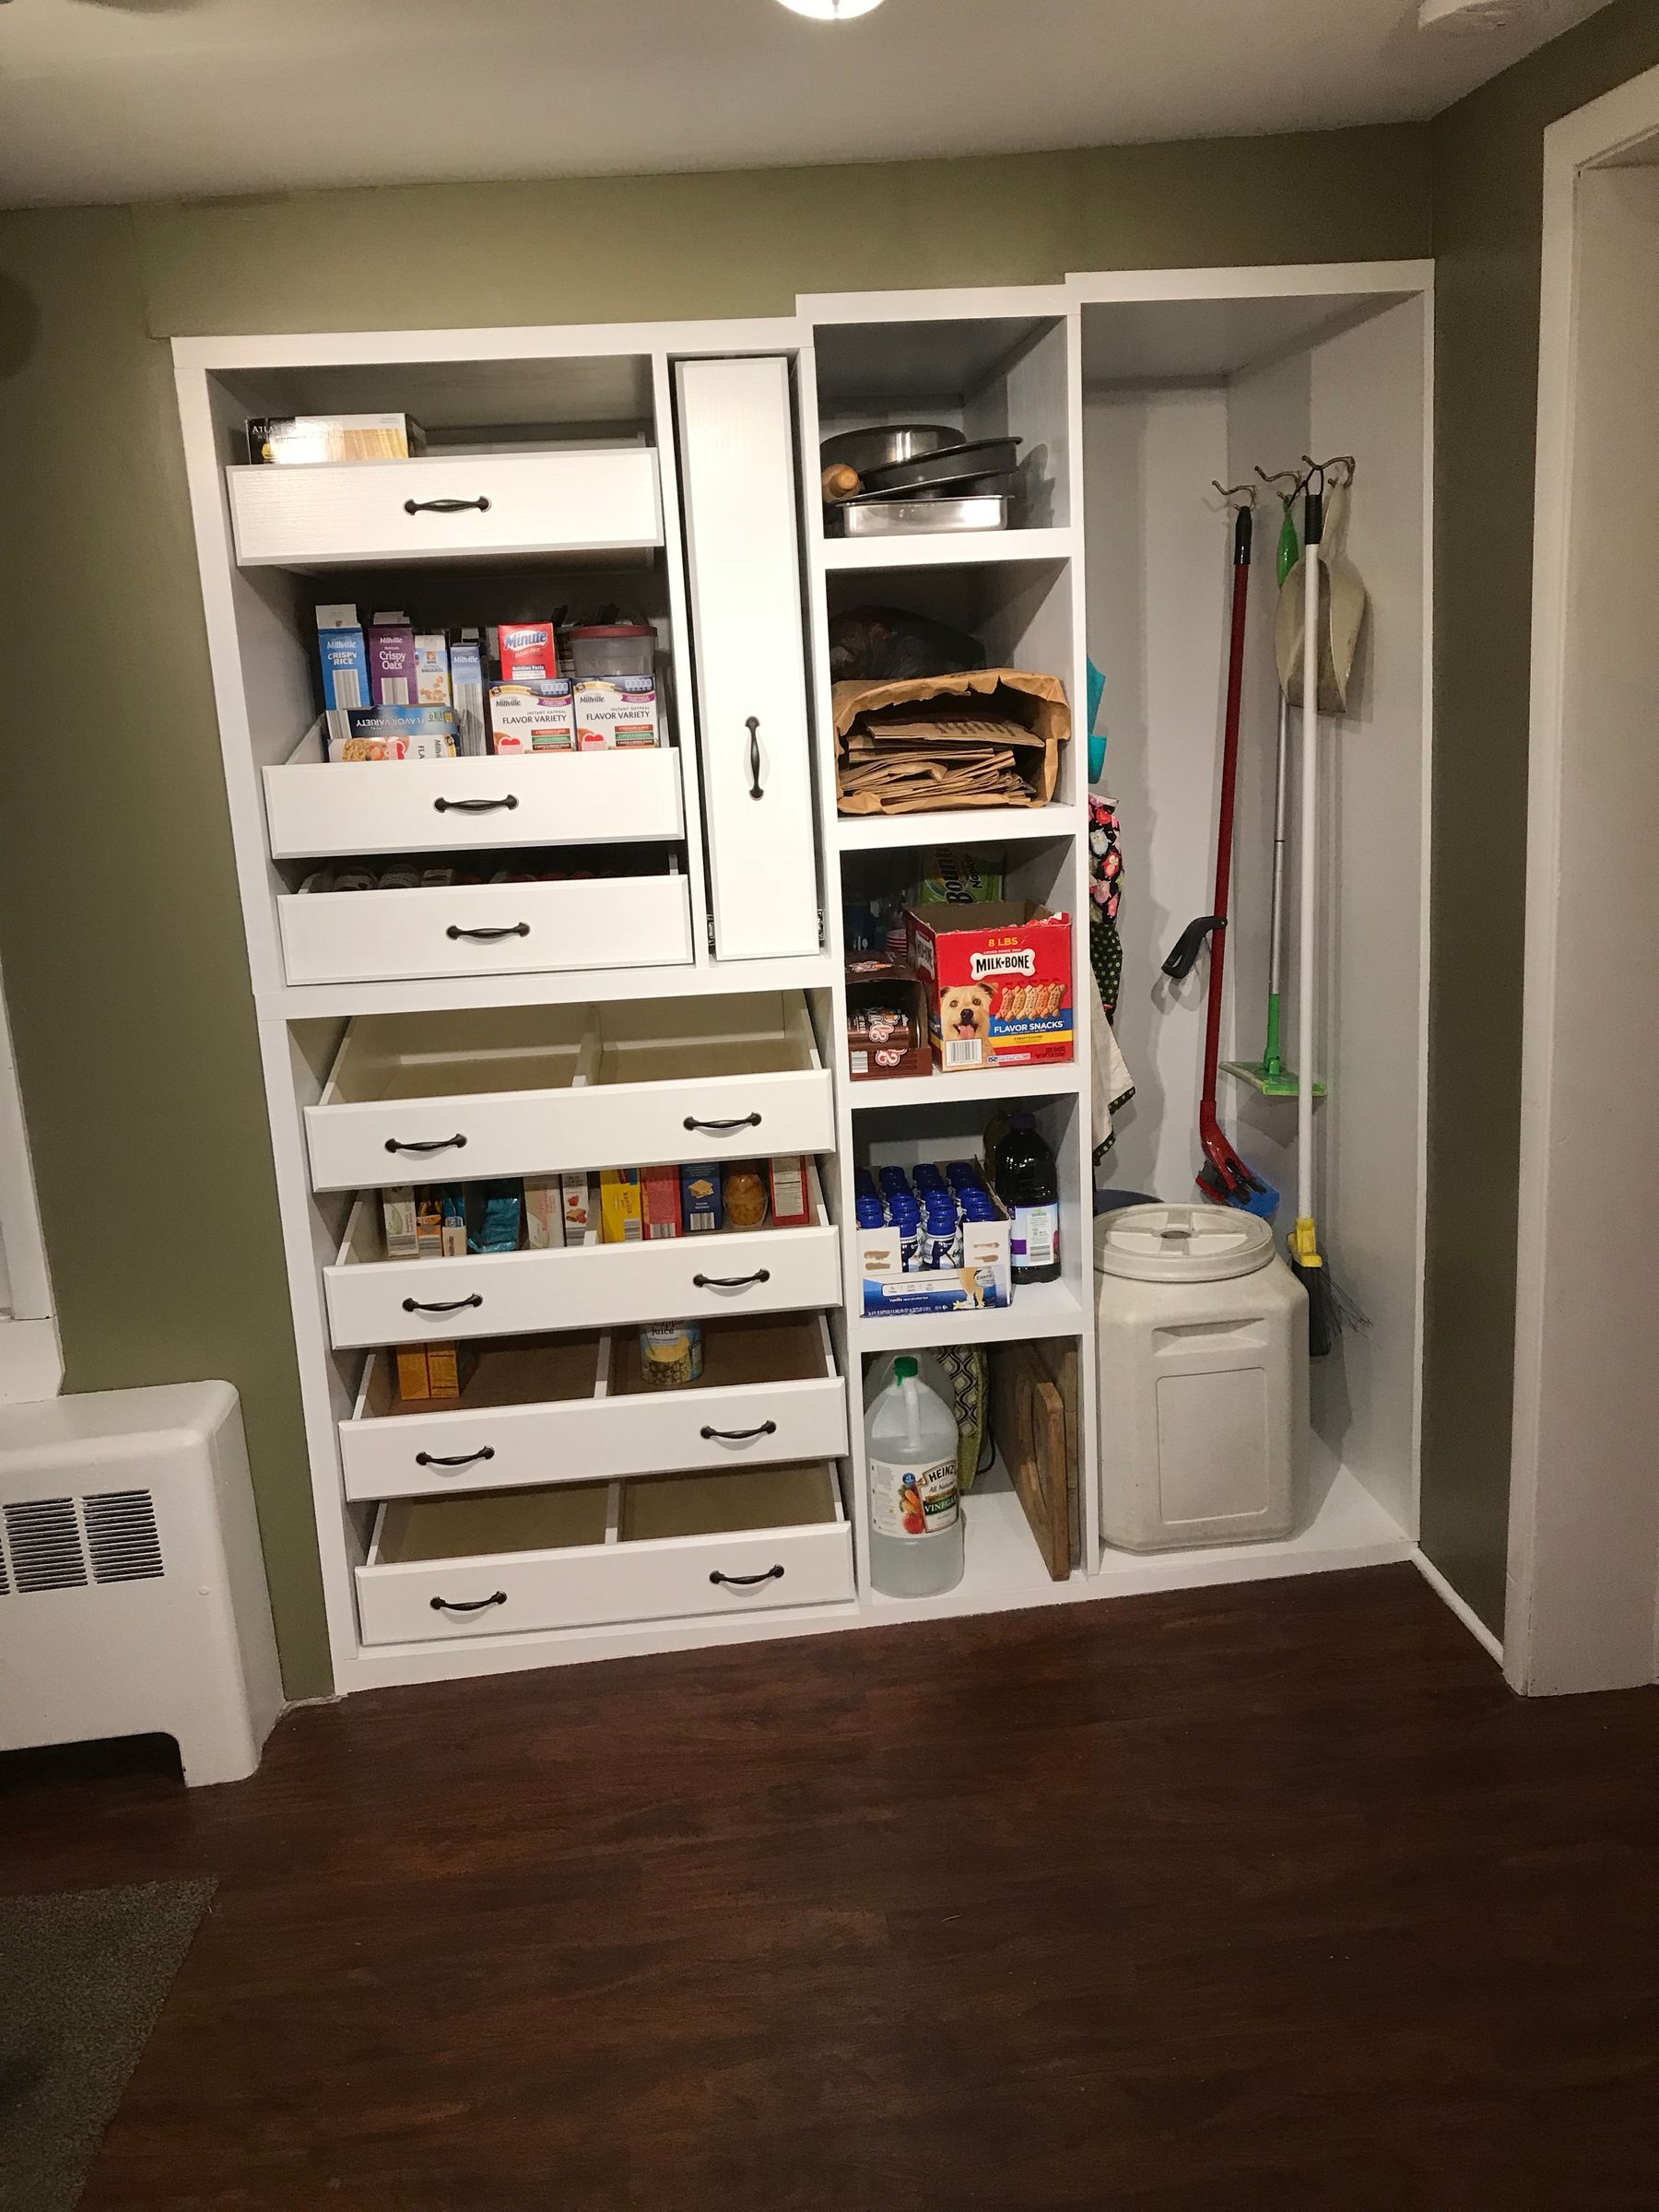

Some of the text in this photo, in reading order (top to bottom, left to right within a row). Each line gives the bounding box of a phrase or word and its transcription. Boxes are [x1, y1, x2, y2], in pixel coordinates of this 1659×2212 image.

[505, 631, 548, 649] Minute
[326, 641, 357, 650] Millville
[327, 652, 358, 661] CRISPY
[334, 657, 355, 665] RICE
[379, 651, 406, 662] Crispy
[453, 655, 479, 664] Millville
[382, 660, 403, 670] Oats
[356, 716, 424, 726] FLAVOR VARIETY
[502, 714, 567, 724] FLAVOR VARIETY
[586, 712, 616, 721] FLAVOR
[987, 936, 1018, 947] 8 LBS
[994, 1023, 1028, 1033] FLAVOR
[1029, 1020, 1064, 1030] SNACKS
[651, 1326, 674, 1336] juice
[928, 1465, 955, 1482] HEINZ
[925, 1496, 958, 1512] VINEGA
